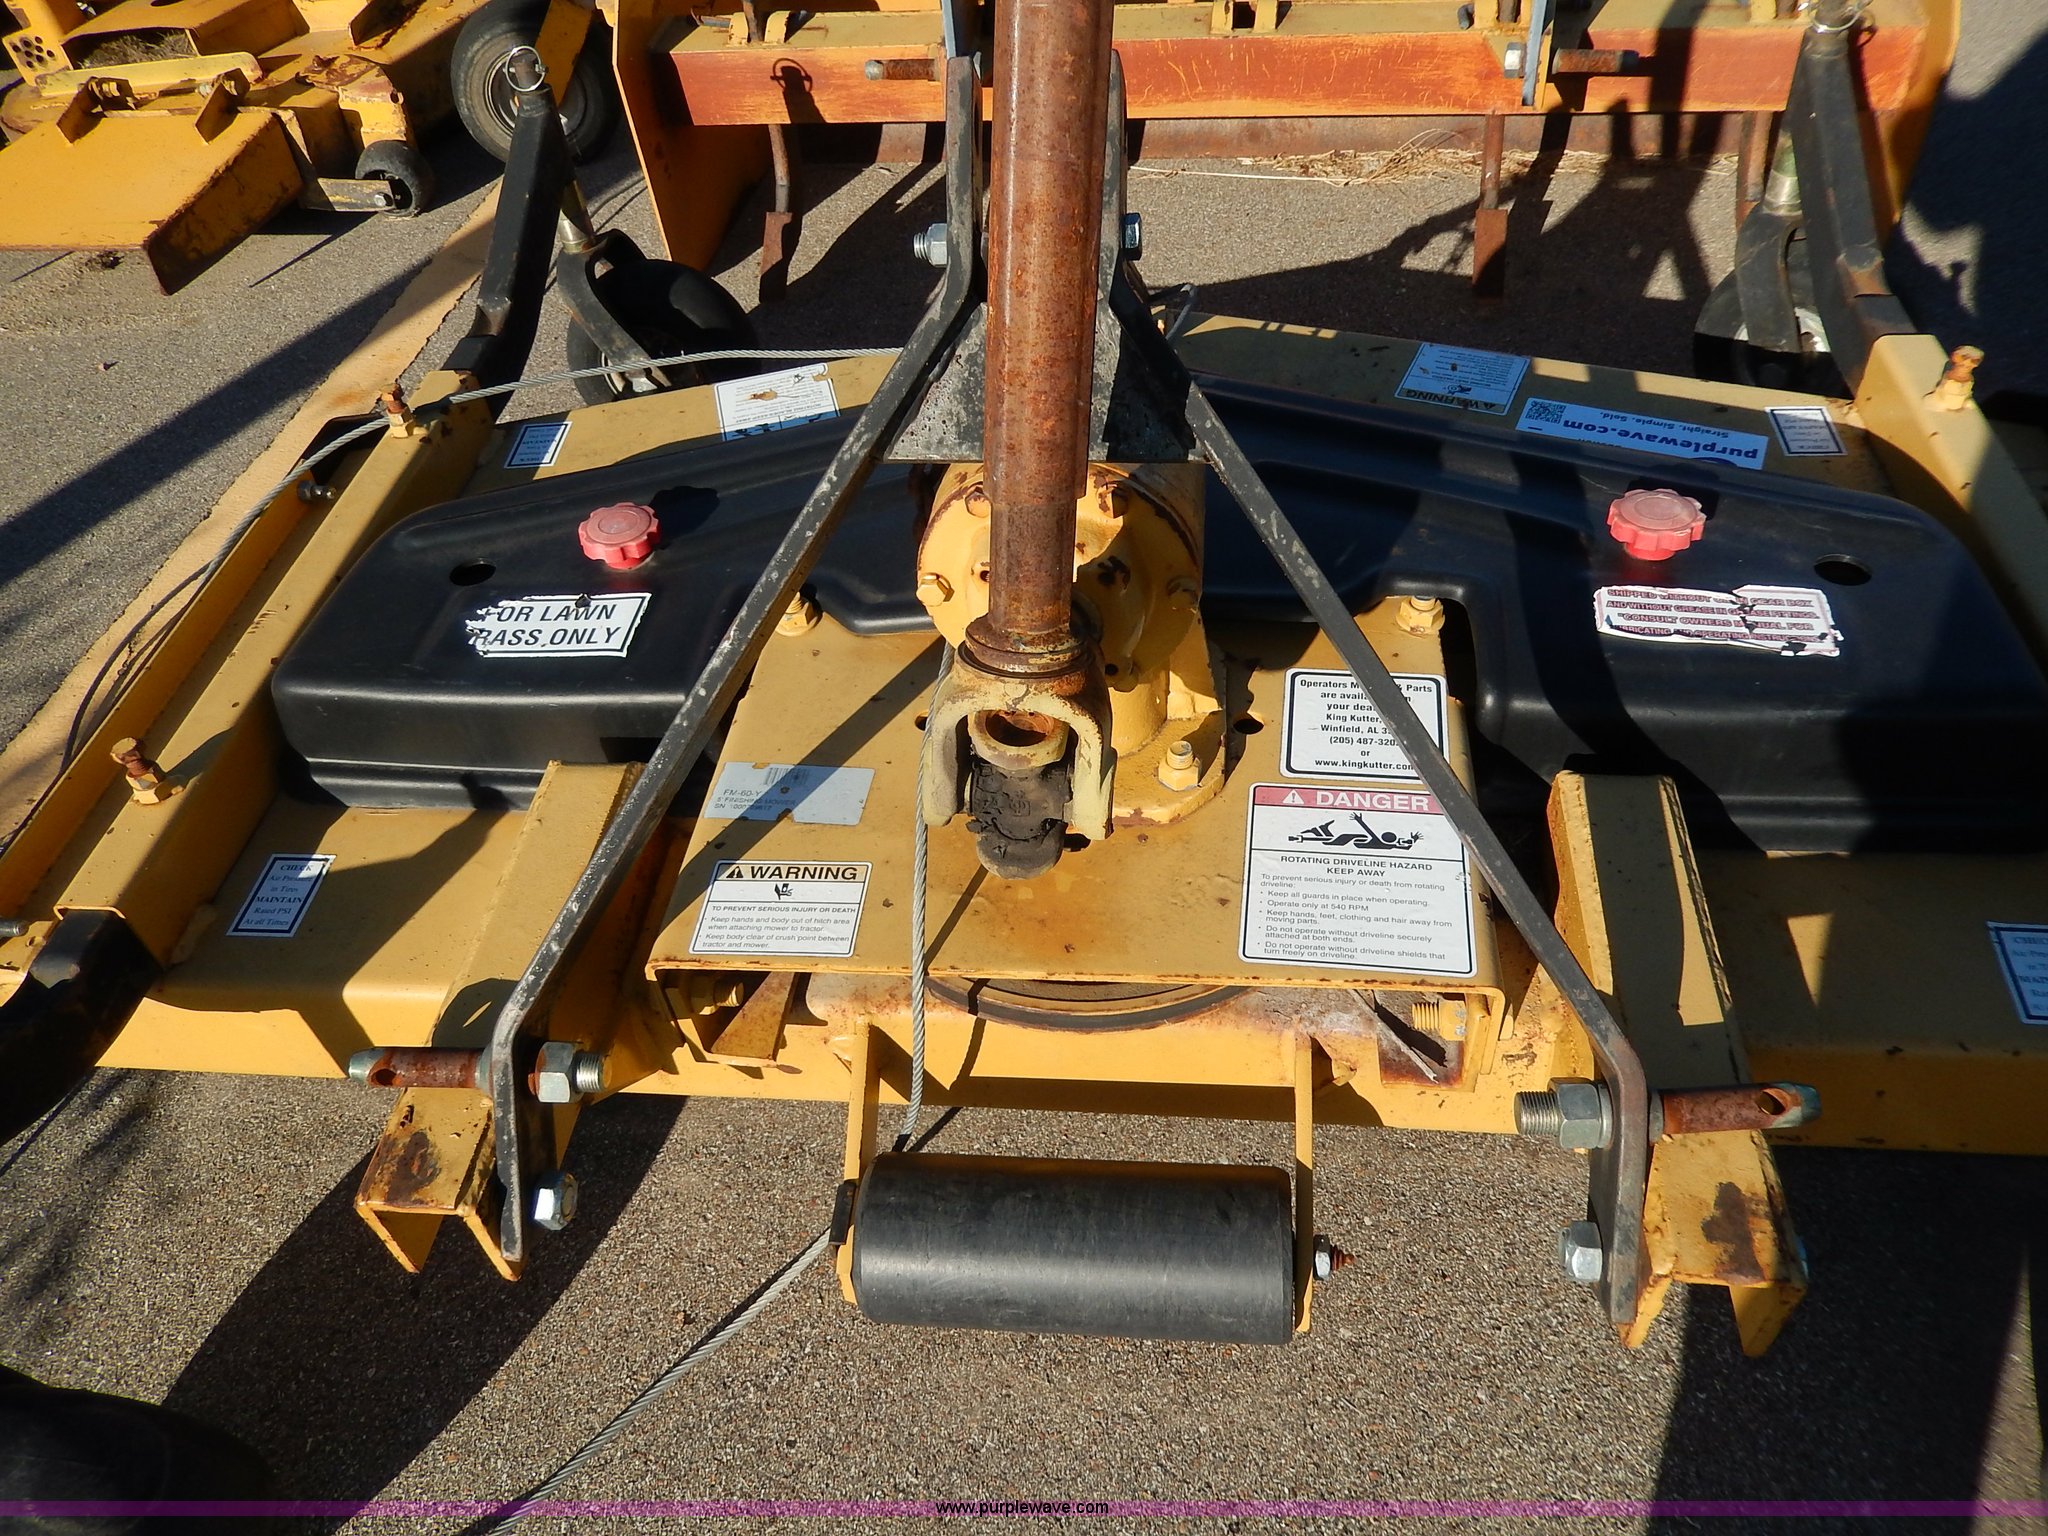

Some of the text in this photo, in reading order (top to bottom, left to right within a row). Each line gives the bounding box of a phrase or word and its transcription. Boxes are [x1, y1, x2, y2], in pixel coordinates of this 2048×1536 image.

[1632, 416, 1675, 430] Simple.
[1679, 424, 1729, 438] Straight.
[1563, 419, 1758, 459] purplewave.com
[1608, 589, 1657, 599] SHIPPED
[1750, 598, 1786, 606] GEAR
[540, 604, 617, 622] LAWN
[1628, 602, 1673, 611] WITHOUT
[1674, 605, 1715, 614] GREASE
[1728, 608, 1770, 617] GRASE
[1680, 617, 1732, 627] OWNERS
[1786, 622, 1814, 630] FOR
[549, 627, 621, 646] ONLY
[1300, 679, 1348, 689] Operators
[1406, 684, 1432, 693] Parts
[1340, 692, 1367, 700] avail
[1327, 703, 1373, 711] your dea
[1326, 713, 1382, 723] King Kutter,
[1320, 724, 1364, 734] Winfield,
[1367, 726, 1380, 734] AL
[1329, 736, 1399, 747] (205) 487-320
[1316, 791, 1429, 811] DANGER
[1280, 855, 1433, 871] ROTATING DRIVELINE HAZARD
[750, 866, 857, 880] WARNING
[1326, 867, 1386, 877] KEEP AWAY
[1334, 877, 1357, 886] injury
[1369, 879, 1392, 887] death
[1414, 883, 1445, 892] rotating
[1267, 890, 1289, 898] Keep
[1302, 892, 1330, 900] guards
[1341, 894, 1363, 902] place
[1267, 899, 1300, 907] Operate
[1301, 902, 1319, 910] only
[1265, 916, 1295, 924] moving
[1266, 909, 1288, 917] Keep
[1340, 914, 1371, 923] clothing
[1409, 919, 1431, 927] away
[1265, 932, 1300, 940] attached
[1294, 927, 1326, 935] operate
[1328, 929, 1358, 937] without
[1360, 931, 1395, 939] driveline
[1397, 934, 1433, 943] securely
[1282, 949, 1305, 957] freely
[1328, 945, 1358, 953] without
[1360, 947, 1395, 955] driveline
[1397, 950, 1427, 958] shields
[1429, 952, 1446, 960] that
